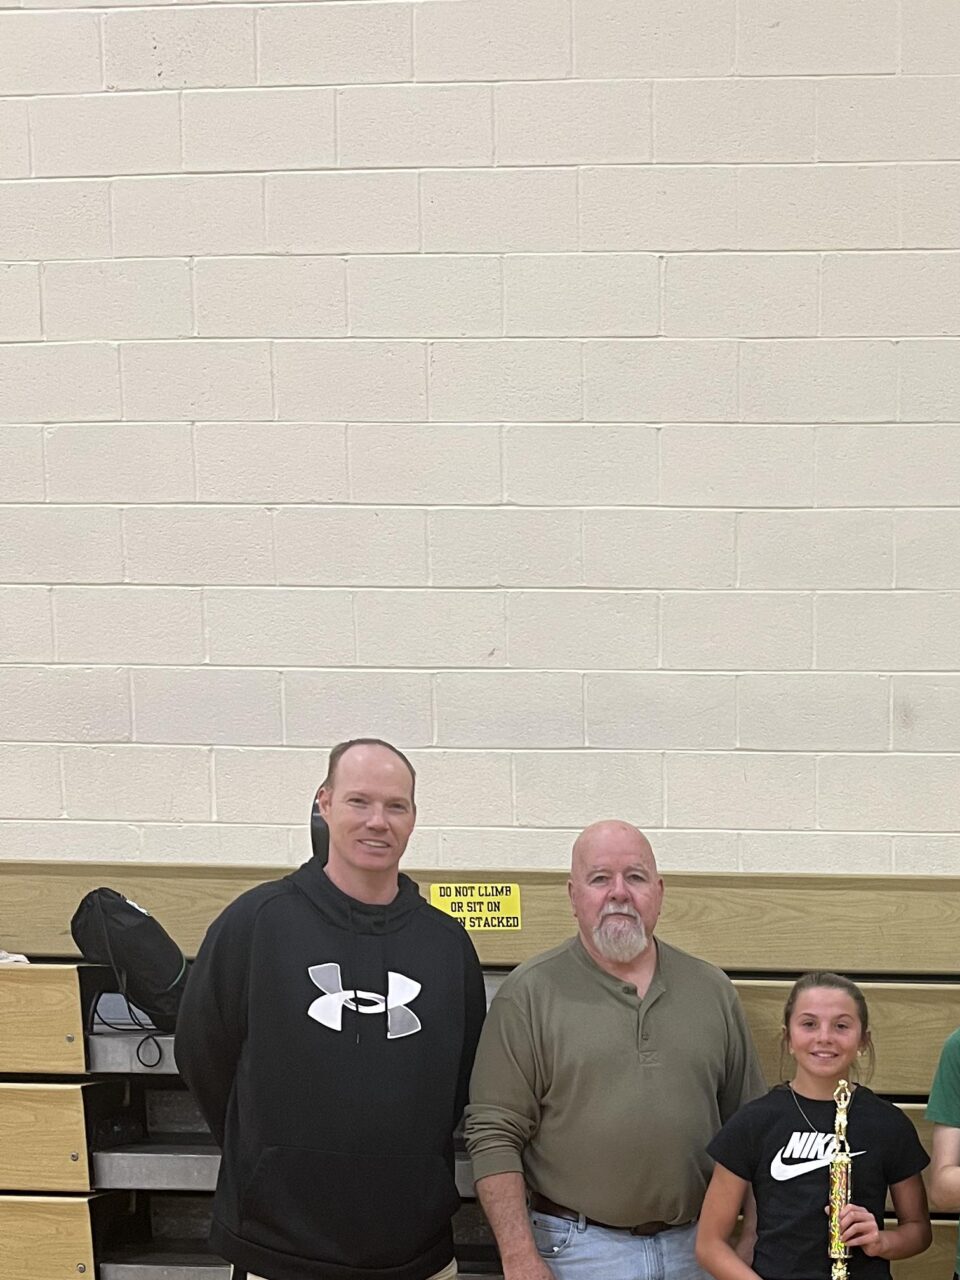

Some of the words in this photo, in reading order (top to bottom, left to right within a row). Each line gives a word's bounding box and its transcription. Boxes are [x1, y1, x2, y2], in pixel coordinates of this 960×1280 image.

[439, 886, 452, 897] DO
[454, 886, 475, 897] NOT
[478, 886, 512, 897] CLIMB
[450, 901, 464, 912] OR
[467, 901, 484, 912] SIT
[487, 901, 501, 912] ON
[469, 916, 519, 928] STACKED
